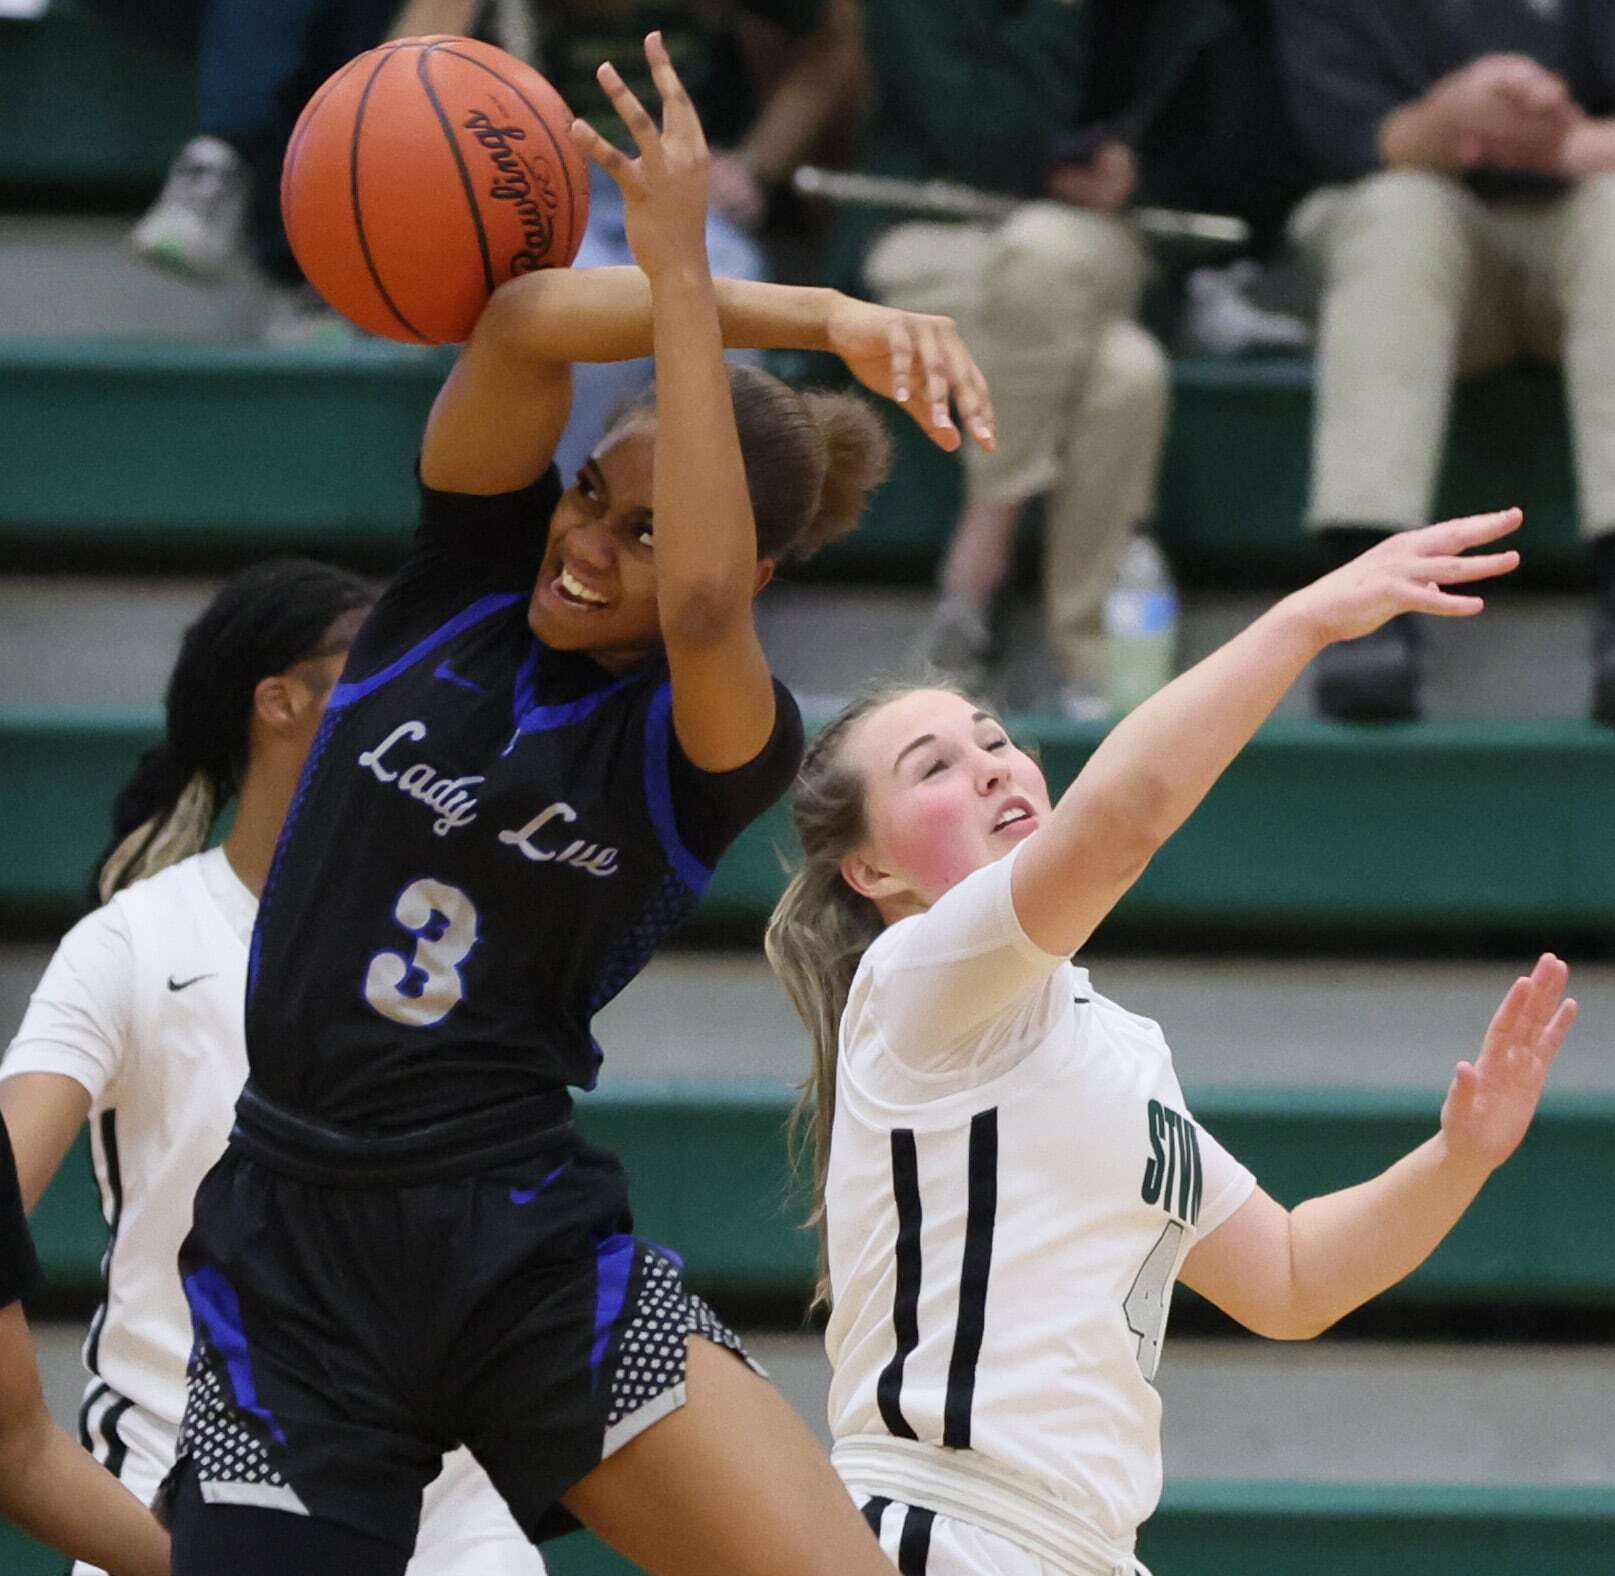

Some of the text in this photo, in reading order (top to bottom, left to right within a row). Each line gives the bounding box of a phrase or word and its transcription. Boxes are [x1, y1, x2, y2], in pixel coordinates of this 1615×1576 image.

[464, 108, 556, 275] Rawlings
[358, 720, 485, 836] Lady
[363, 877, 479, 1027] 3
